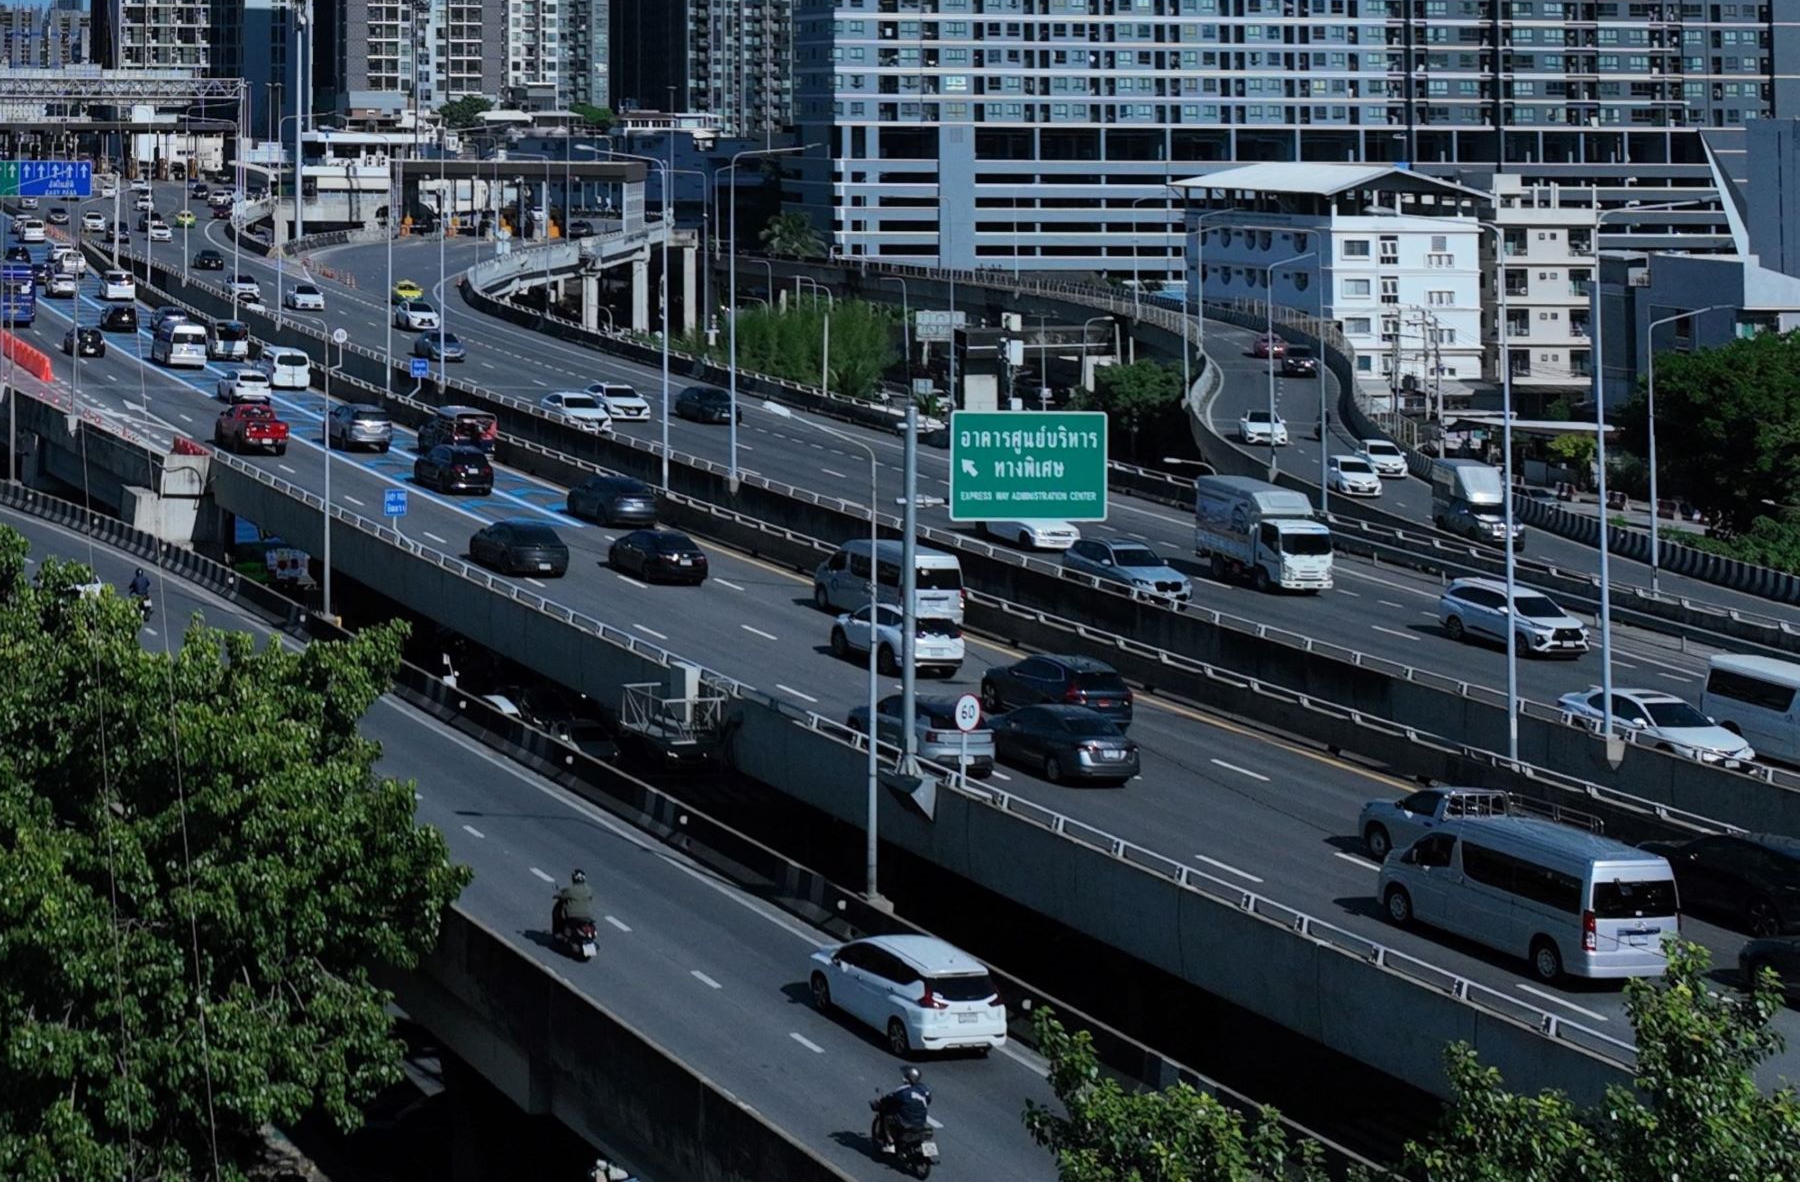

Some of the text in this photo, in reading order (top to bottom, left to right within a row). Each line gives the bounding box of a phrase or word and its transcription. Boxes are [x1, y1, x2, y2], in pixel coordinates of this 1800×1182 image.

[961, 425, 1097, 454] อาคารศูนย์บริหาร
[995, 456, 1064, 478] ทางพิเศษ
[960, 491, 992, 501] EXPRESS
[1070, 491, 1097, 501] CENTER
[962, 704, 975, 719] 60
